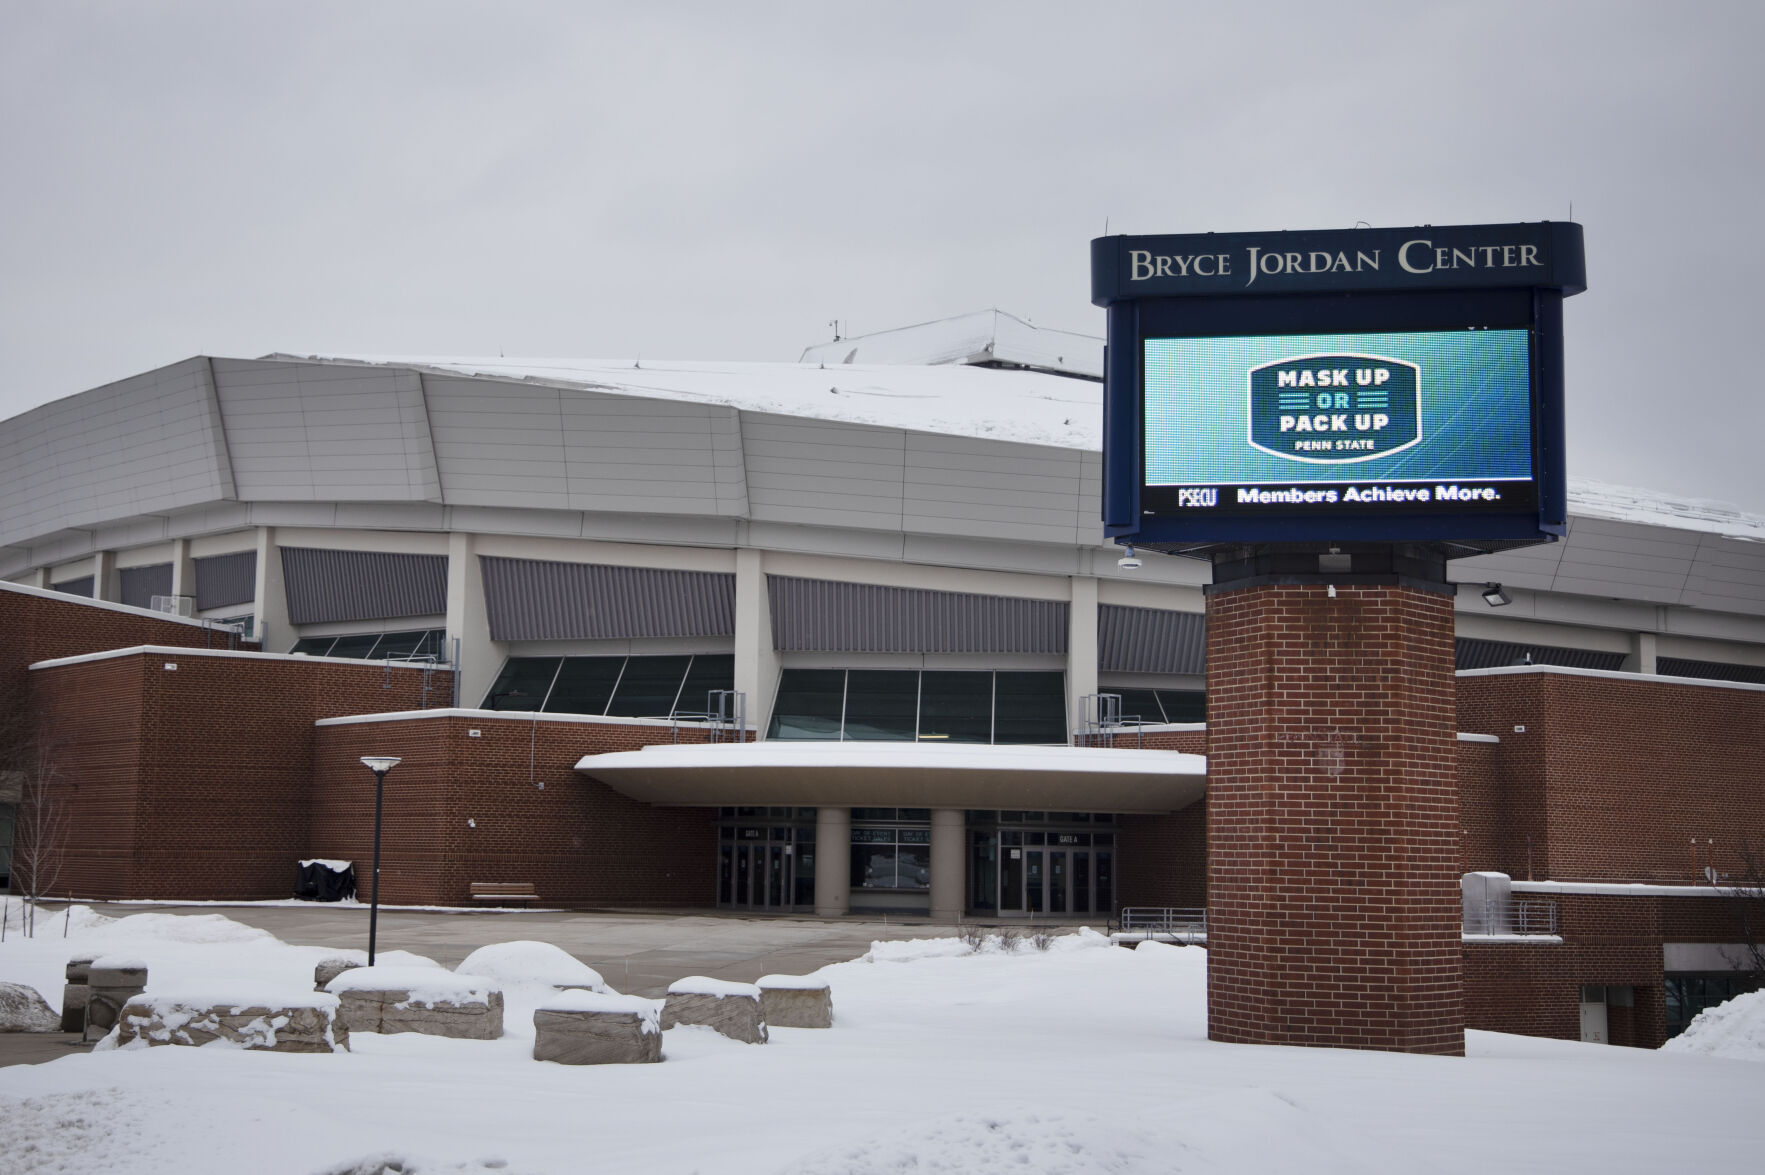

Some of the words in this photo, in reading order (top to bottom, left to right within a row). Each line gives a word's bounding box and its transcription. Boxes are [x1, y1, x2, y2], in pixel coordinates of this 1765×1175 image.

[1129, 250, 1231, 281] BRYCE
[1246, 246, 1382, 288] JORDAN
[1398, 239, 1545, 274] CENTER
[1277, 368, 1350, 388] MASK
[1355, 367, 1391, 387] UP
[1316, 392, 1350, 409] OR
[1279, 414, 1348, 433] PACK
[1353, 413, 1390, 431] UP
[1294, 440, 1332, 451] PENN
[1335, 439, 1375, 451] STATE
[1178, 488, 1217, 508] PSECU
[1237, 487, 1338, 504] Members
[1343, 486, 1430, 502] Achieve
[1434, 485, 1502, 501] More.
[1059, 835, 1073, 843] GATE
